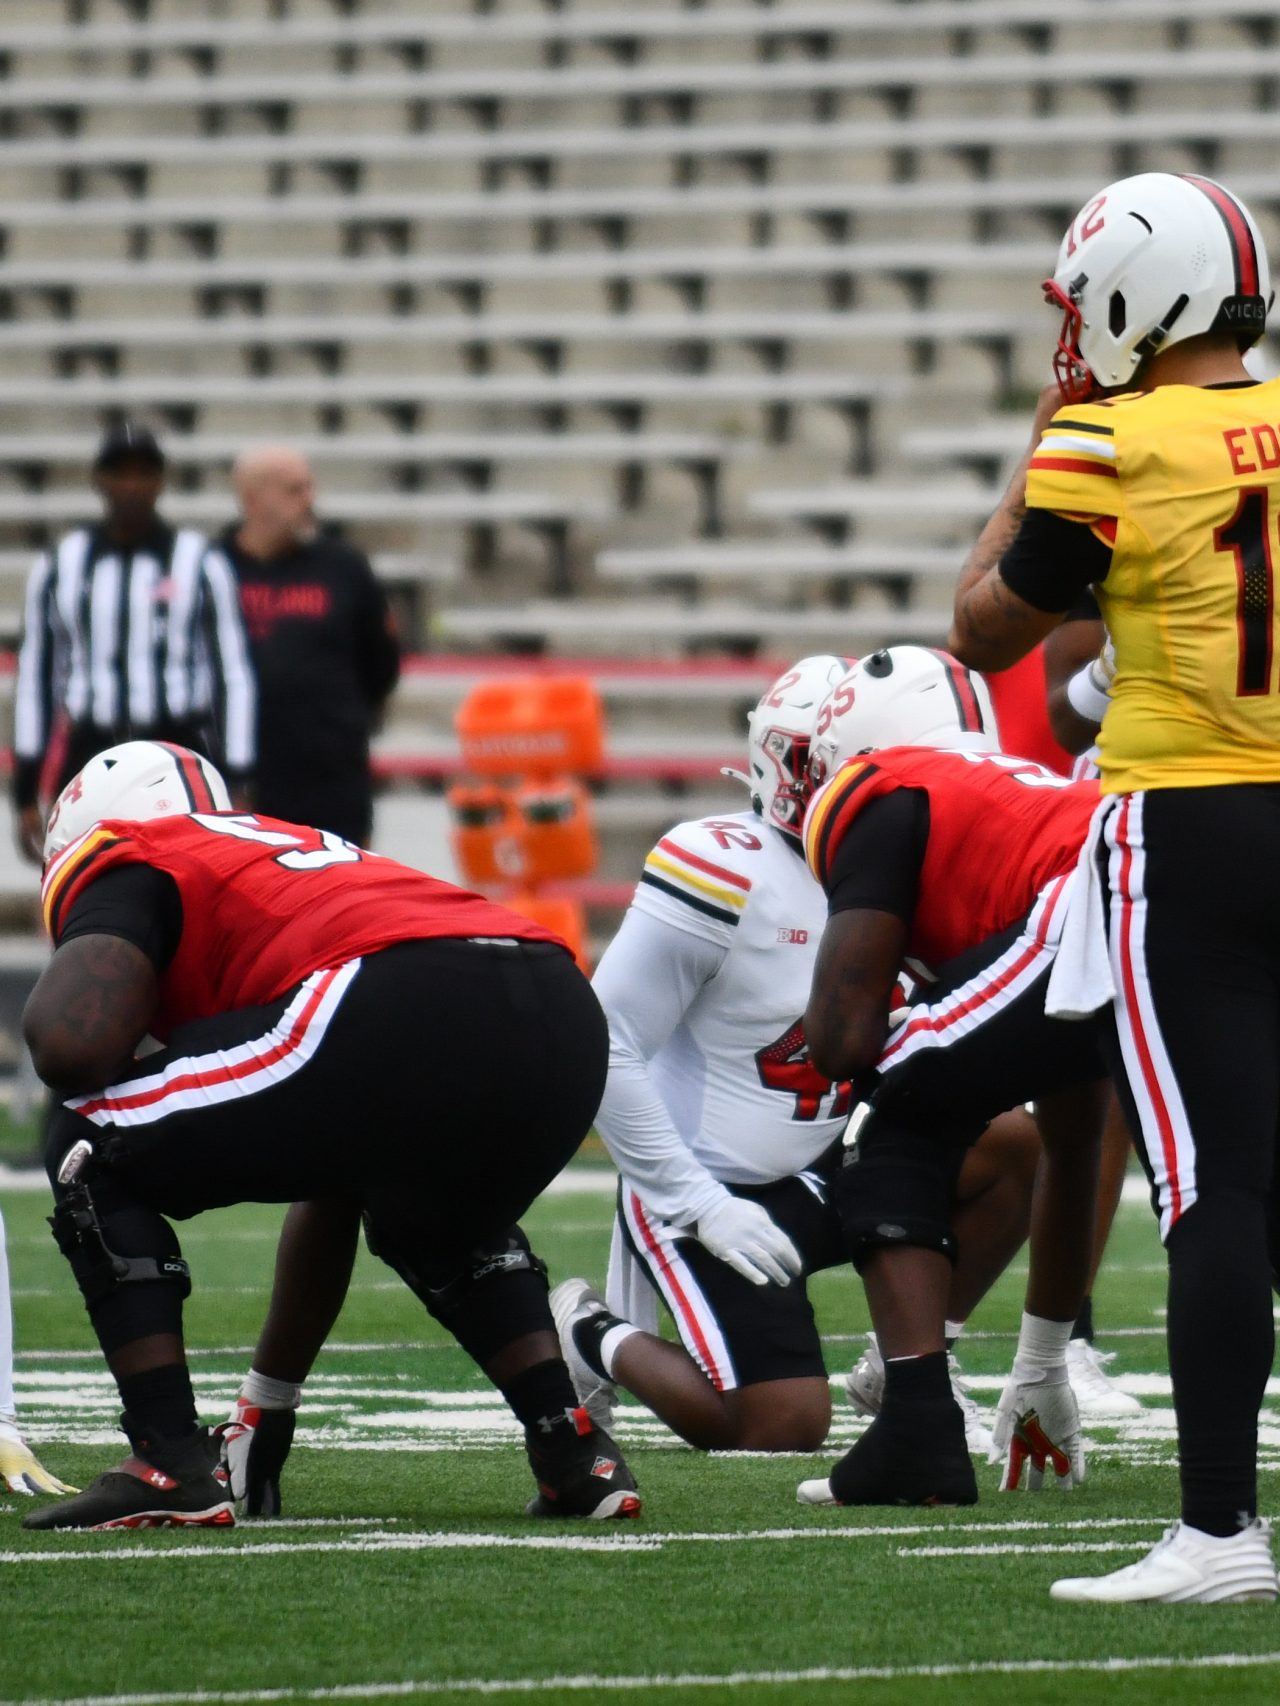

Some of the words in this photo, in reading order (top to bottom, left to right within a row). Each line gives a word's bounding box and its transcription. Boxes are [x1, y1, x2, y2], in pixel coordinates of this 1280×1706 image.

[1223, 303, 1264, 319] VICIS
[816, 674, 856, 735] 55
[699, 820, 763, 851] 42
[754, 1015, 853, 1121] 4
